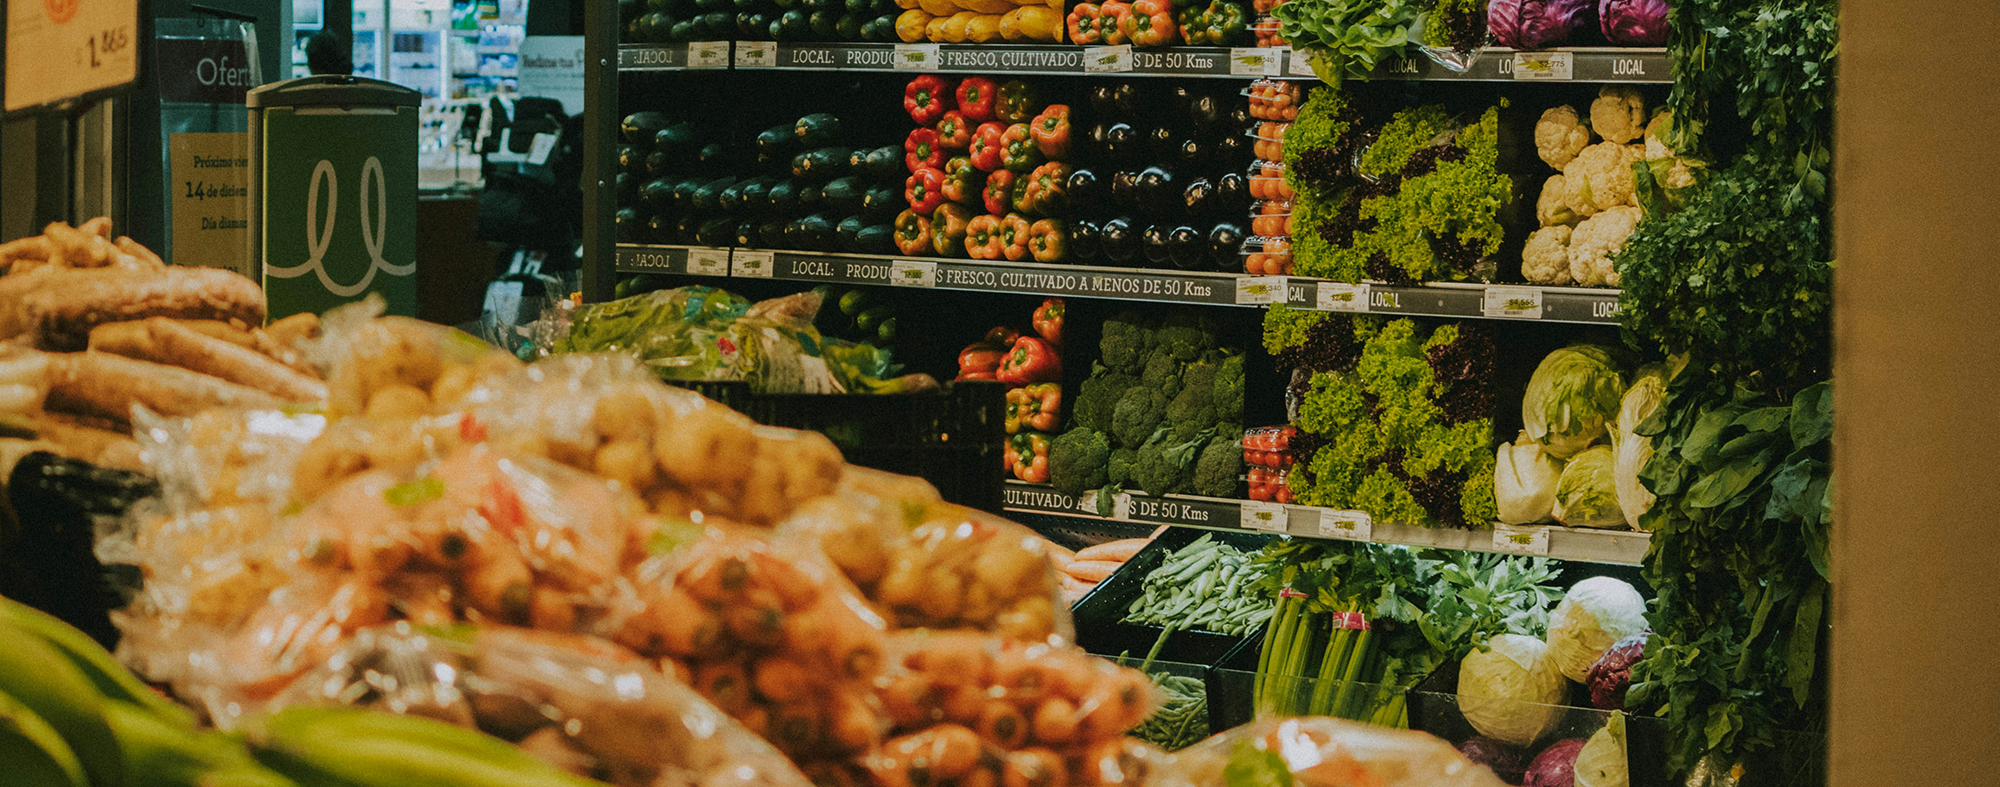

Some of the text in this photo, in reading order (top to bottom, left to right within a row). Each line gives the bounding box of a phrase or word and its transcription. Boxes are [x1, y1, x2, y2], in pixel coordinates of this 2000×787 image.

[792, 49, 835, 64] LOCAL:
[846, 50, 895, 65] PRODUC
[947, 51, 998, 68] FRESCO,
[1001, 51, 1078, 67] CULTIVADO
[1144, 53, 1163, 68] DE
[1166, 53, 1182, 69] 50
[1185, 54, 1213, 69] Kms
[1388, 58, 1419, 73] LOCAL
[1612, 59, 1646, 75] LOCAL
[197, 55, 250, 86] Ofert
[185, 181, 205, 201] 14
[206, 184, 218, 198] de
[792, 260, 835, 276] LOCAL:
[946, 269, 997, 288] FRESCO,
[1000, 272, 1076, 290] CULTIVADO
[1079, 276, 1089, 291] A
[1091, 276, 1140, 294] MENOS
[1143, 279, 1161, 295] DE
[1164, 279, 1181, 296] 50
[1184, 281, 1212, 297] Kms
[1288, 286, 1306, 302] CAL
[1003, 489, 1073, 509] ULTIVADO
[1140, 502, 1158, 517] DE
[1161, 502, 1178, 519] 50
[1181, 505, 1209, 521] Kms
